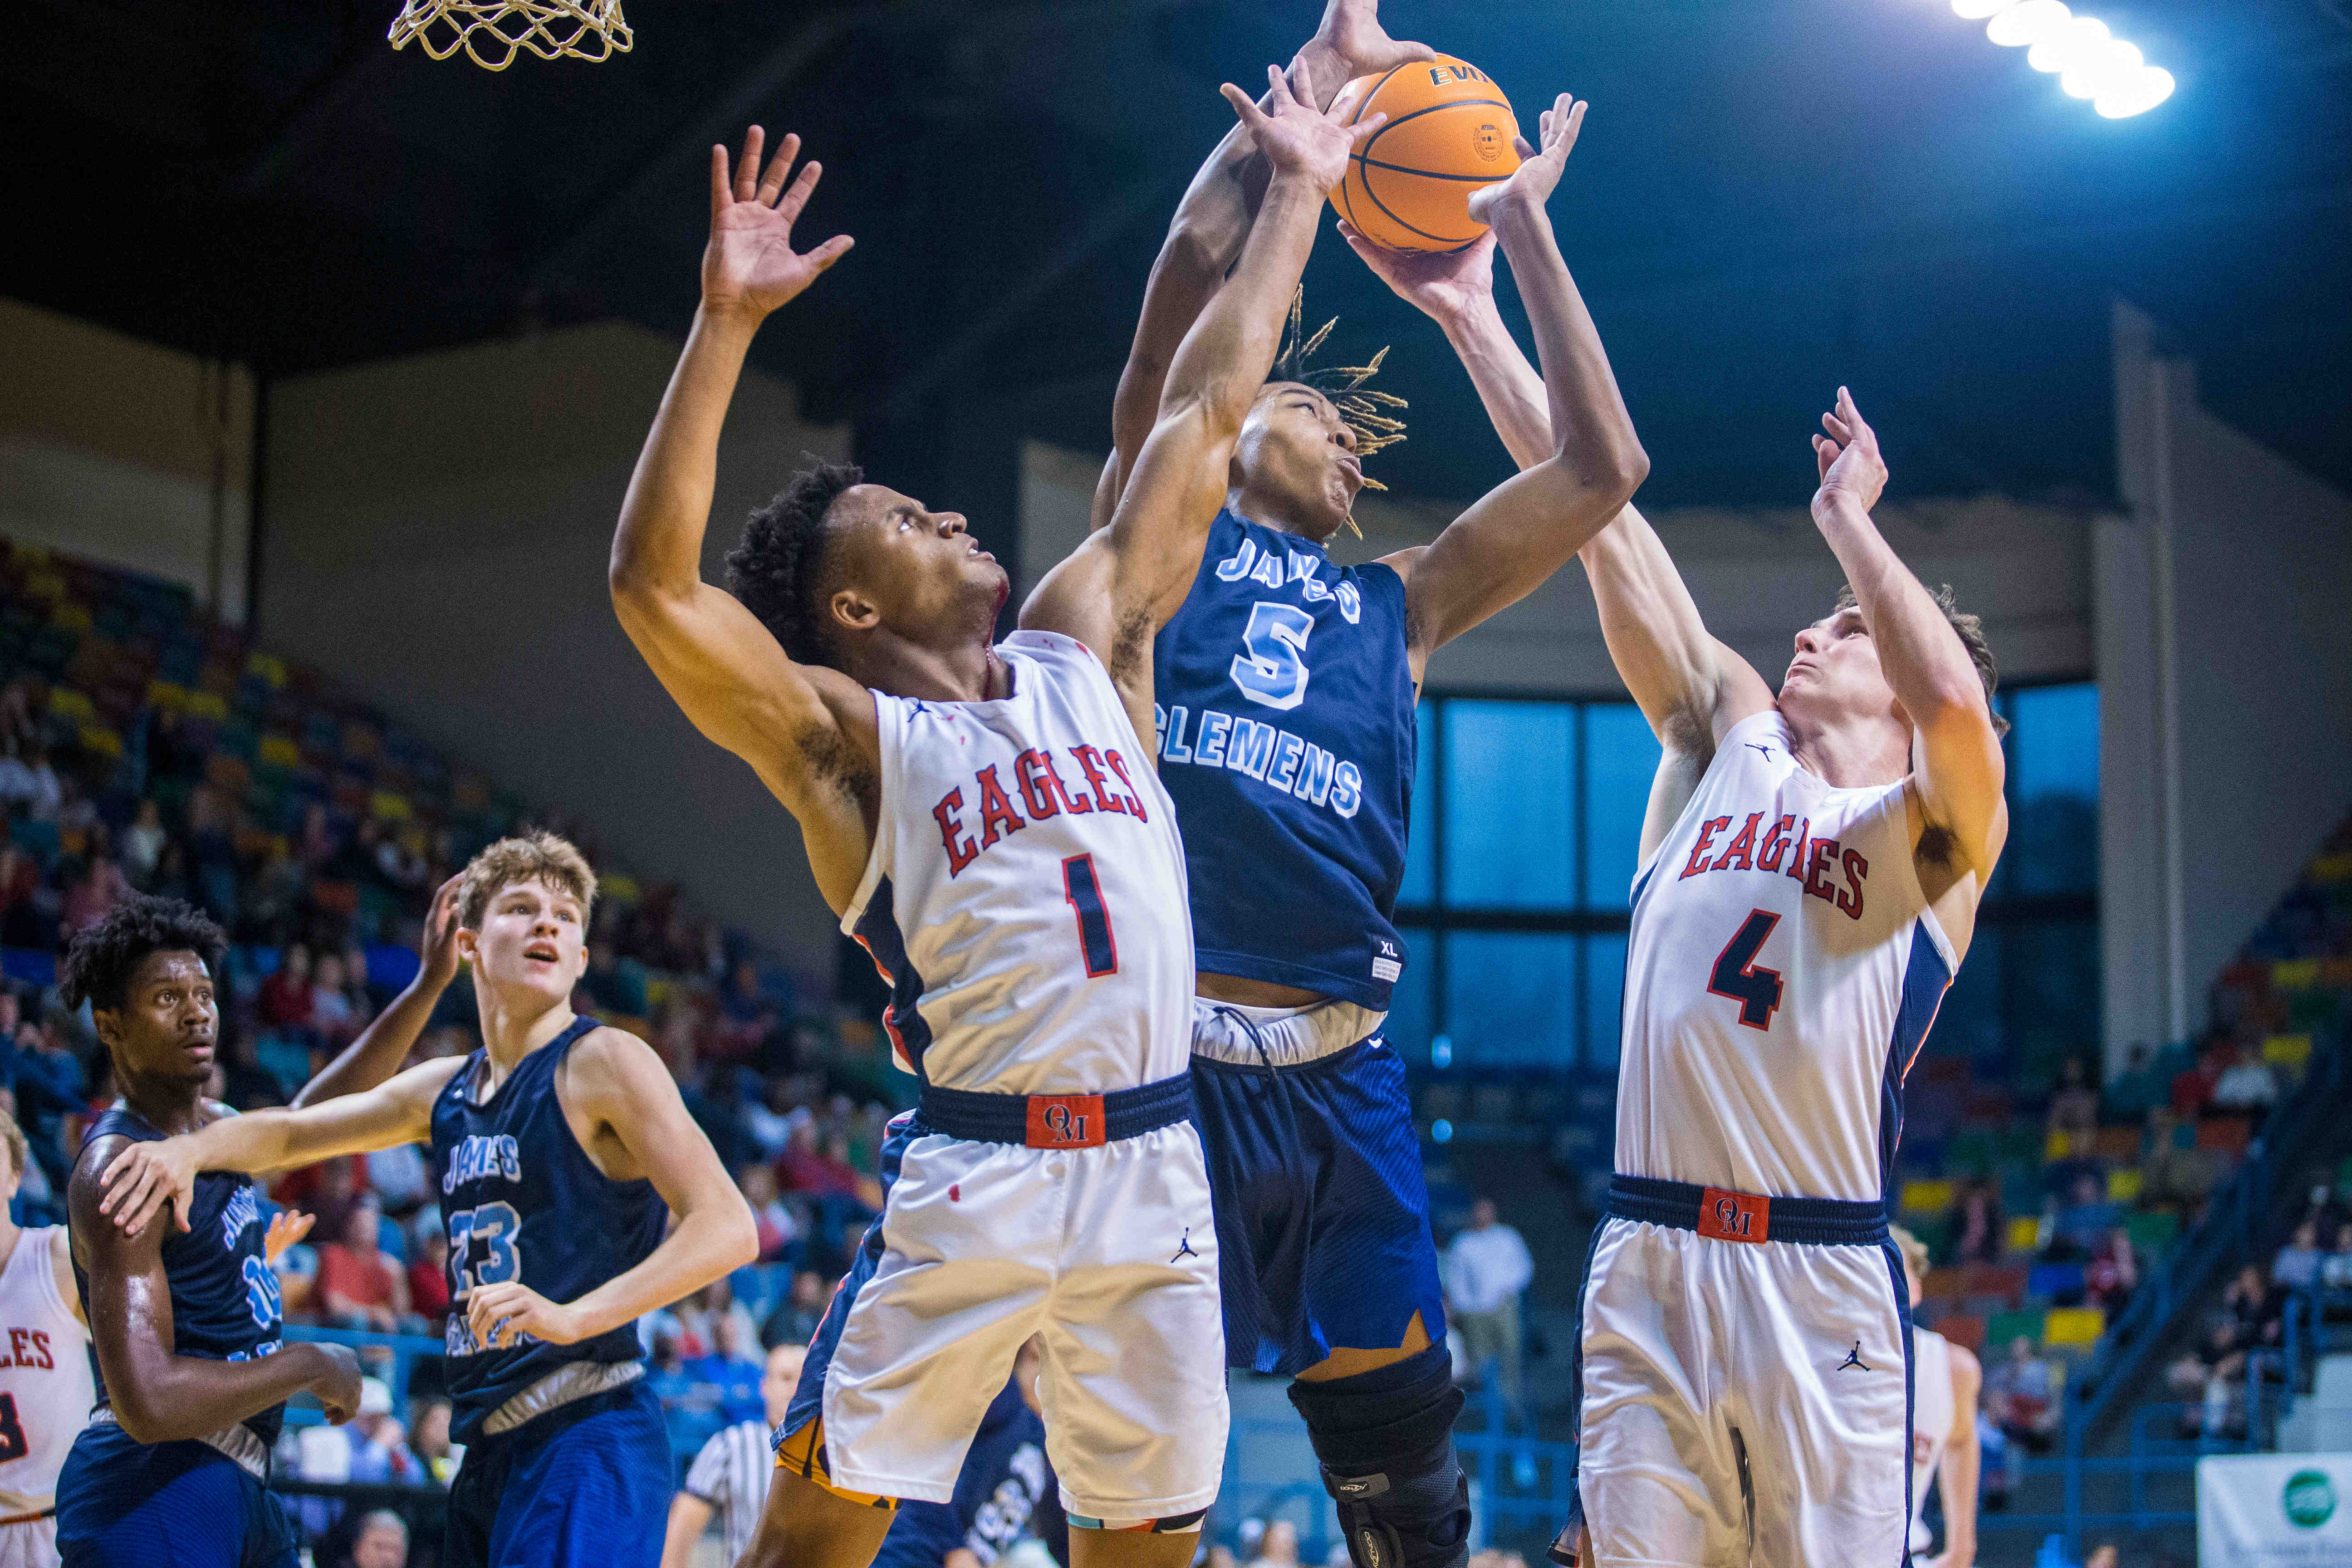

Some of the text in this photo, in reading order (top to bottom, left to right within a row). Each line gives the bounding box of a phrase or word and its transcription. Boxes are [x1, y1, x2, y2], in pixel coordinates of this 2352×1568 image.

[1230, 601, 1314, 710] 5
[932, 744, 1147, 879] EAGLES
[1062, 852, 1118, 979] 1
[1381, 941, 1398, 957] XL
[1706, 908, 1784, 1032] 4
[443, 1133, 522, 1196] JAMES
[449, 1200, 522, 1300] 23
